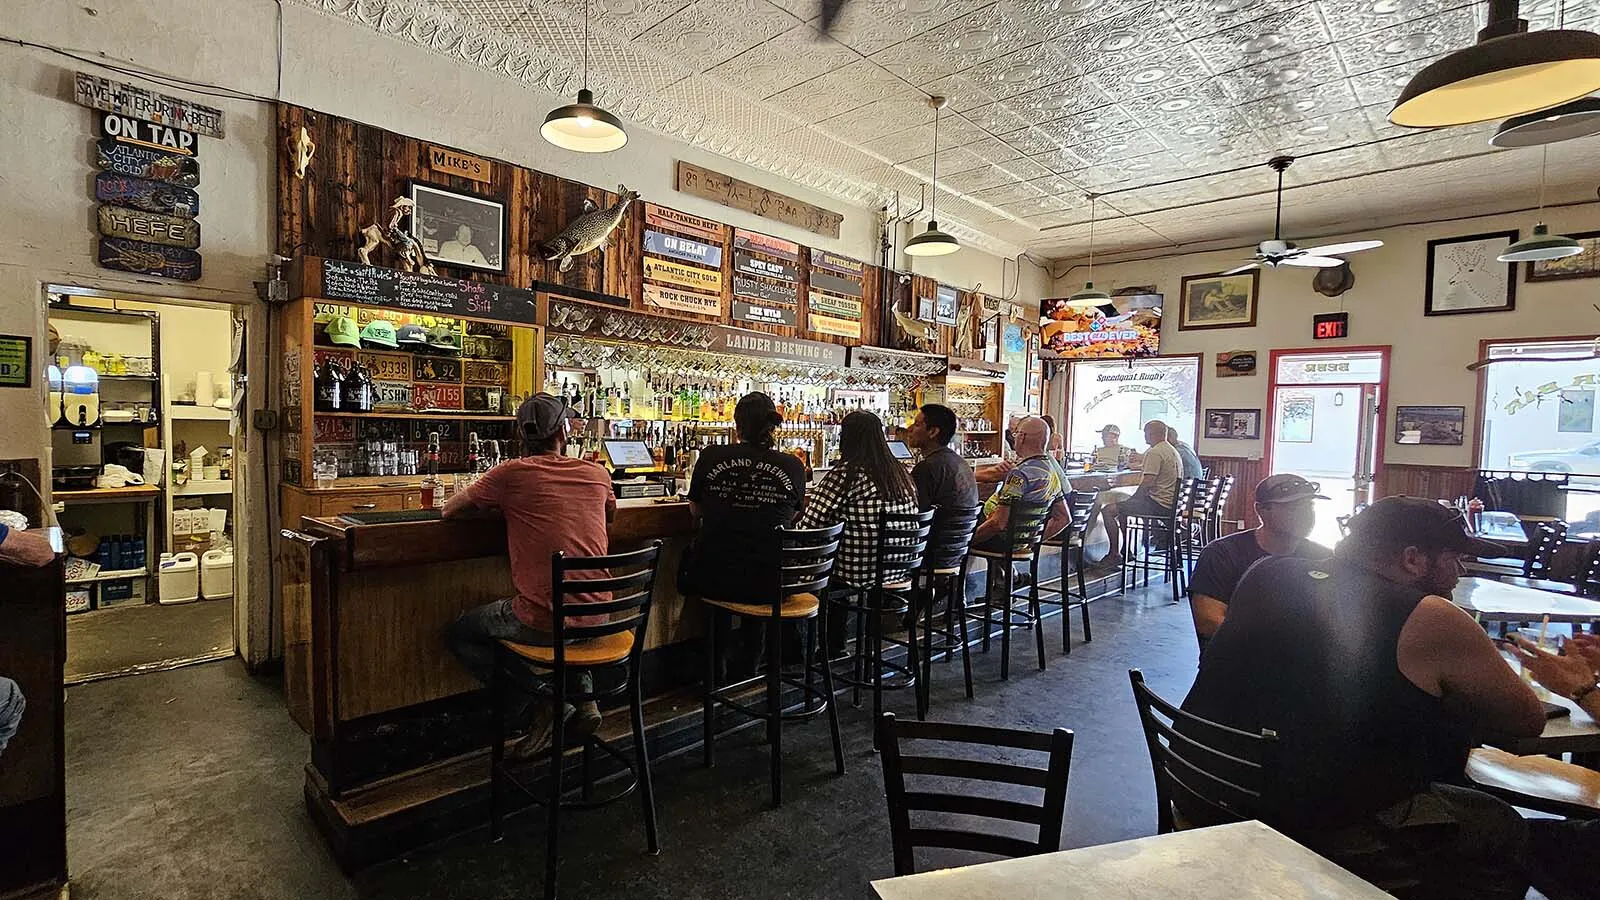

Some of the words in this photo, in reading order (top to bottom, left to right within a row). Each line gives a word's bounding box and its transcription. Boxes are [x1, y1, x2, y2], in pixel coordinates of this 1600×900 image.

[104, 115, 138, 139] ON
[148, 123, 193, 151] TAP
[106, 145, 160, 161] ATLANTIC
[113, 154, 142, 167] CITY
[113, 163, 142, 175] GOLD
[111, 214, 186, 241] HEFE
[664, 237, 678, 250] ON
[679, 239, 709, 257] BELAY
[654, 263, 685, 276] ATLANTIC
[686, 270, 701, 280] CITY
[701, 273, 718, 283] GOLD
[659, 291, 679, 301] ROCK
[680, 294, 703, 305] CHUCK
[704, 298, 717, 308] RYE
[1064, 332, 1089, 342] BEST
[1109, 331, 1137, 340] EVER
[1317, 321, 1344, 337] EXIT
[726, 334, 771, 352] LANDER
[774, 340, 820, 359] BREWING
[381, 361, 408, 375] 9338
[442, 365, 455, 377] 92
[1096, 373, 1138, 383] Speedgoat
[1139, 372, 1165, 381] Rugby
[436, 388, 460, 401] 7155
[438, 424, 450, 437] 92
[706, 458, 752, 480] HARLAND
[756, 462, 793, 491] BREWING
